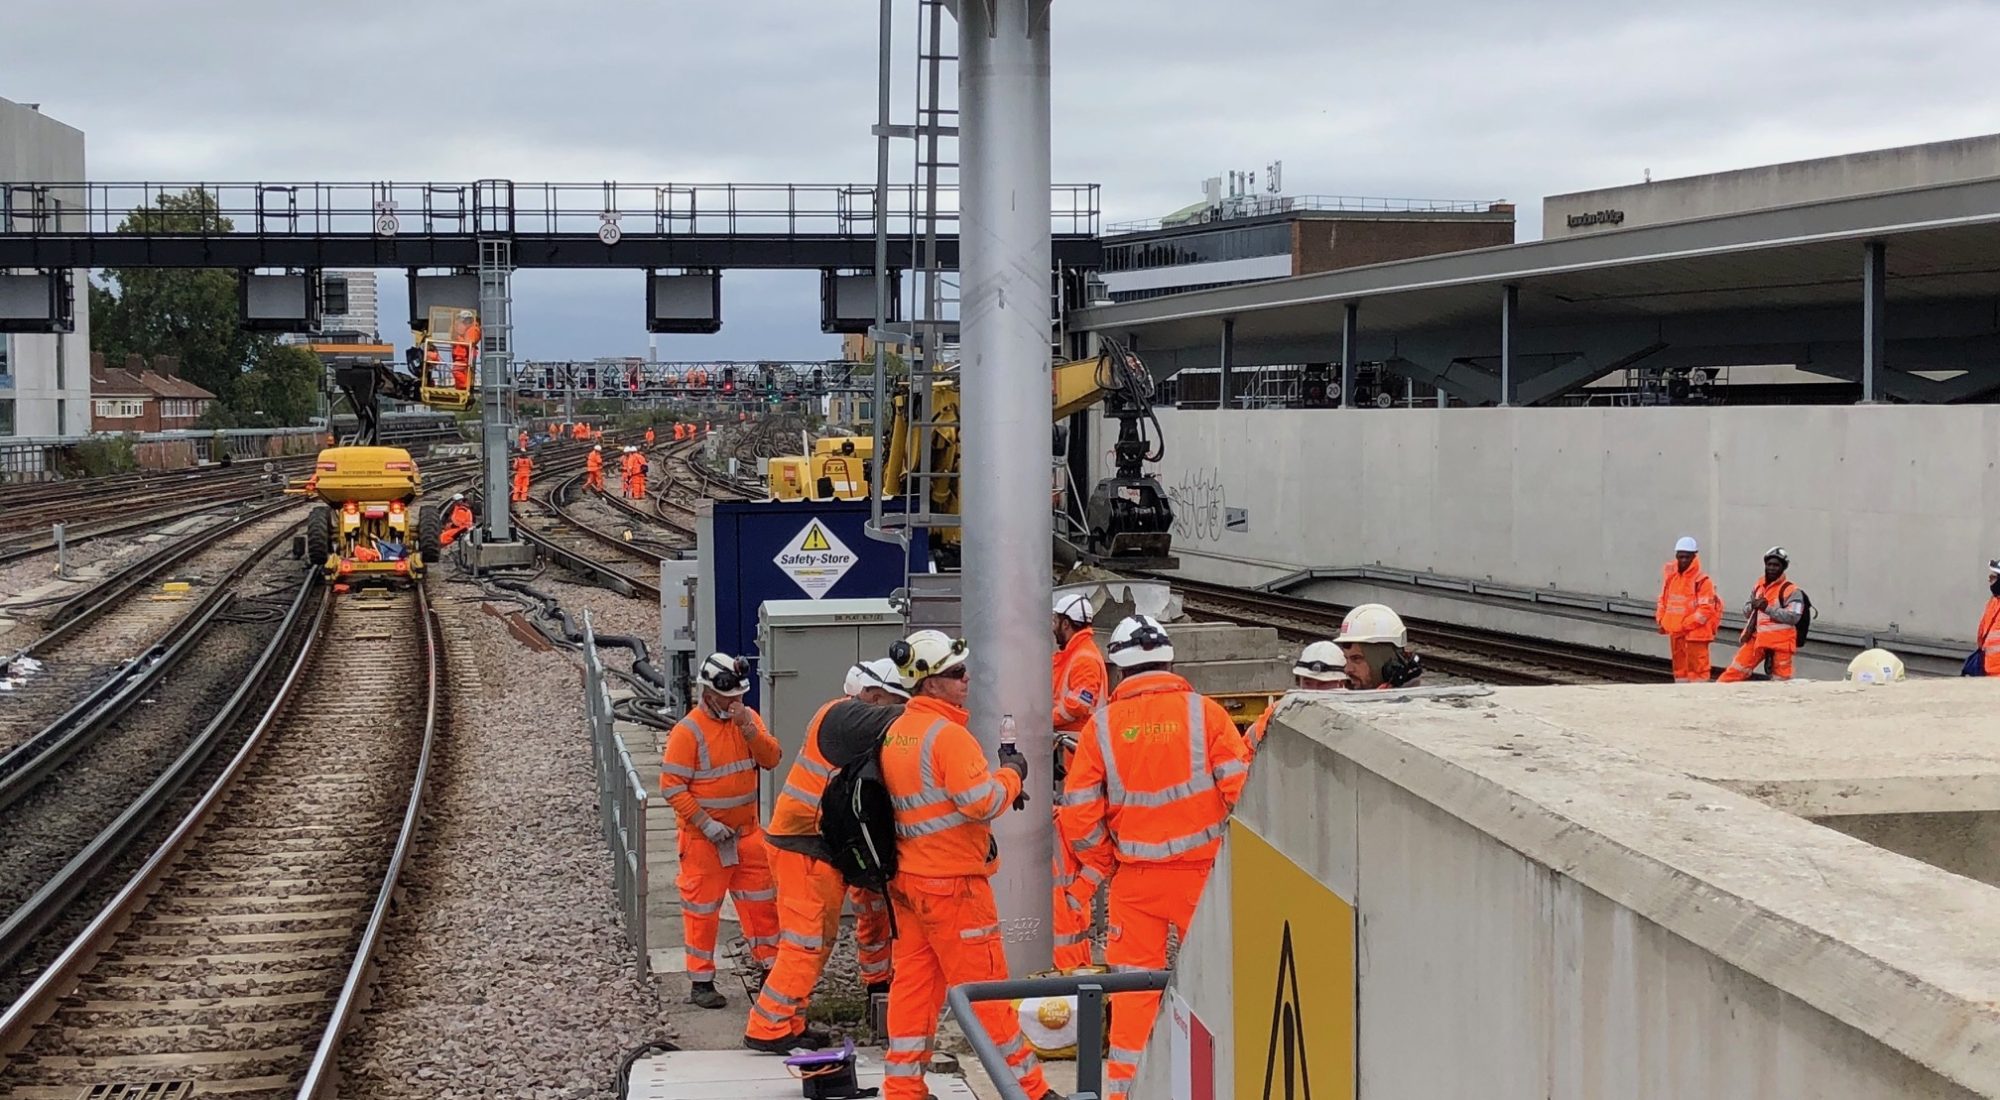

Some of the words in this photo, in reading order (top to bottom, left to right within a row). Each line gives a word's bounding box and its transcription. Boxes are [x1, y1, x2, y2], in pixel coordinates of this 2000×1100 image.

[381, 220, 395, 231] 20
[603, 229, 617, 240] 20
[1328, 386, 1339, 395] 20
[1380, 396, 1389, 405] 20
[780, 553, 850, 566] Safety-Store
[1144, 719, 1179, 736] bam
[896, 732, 918, 746] bam
